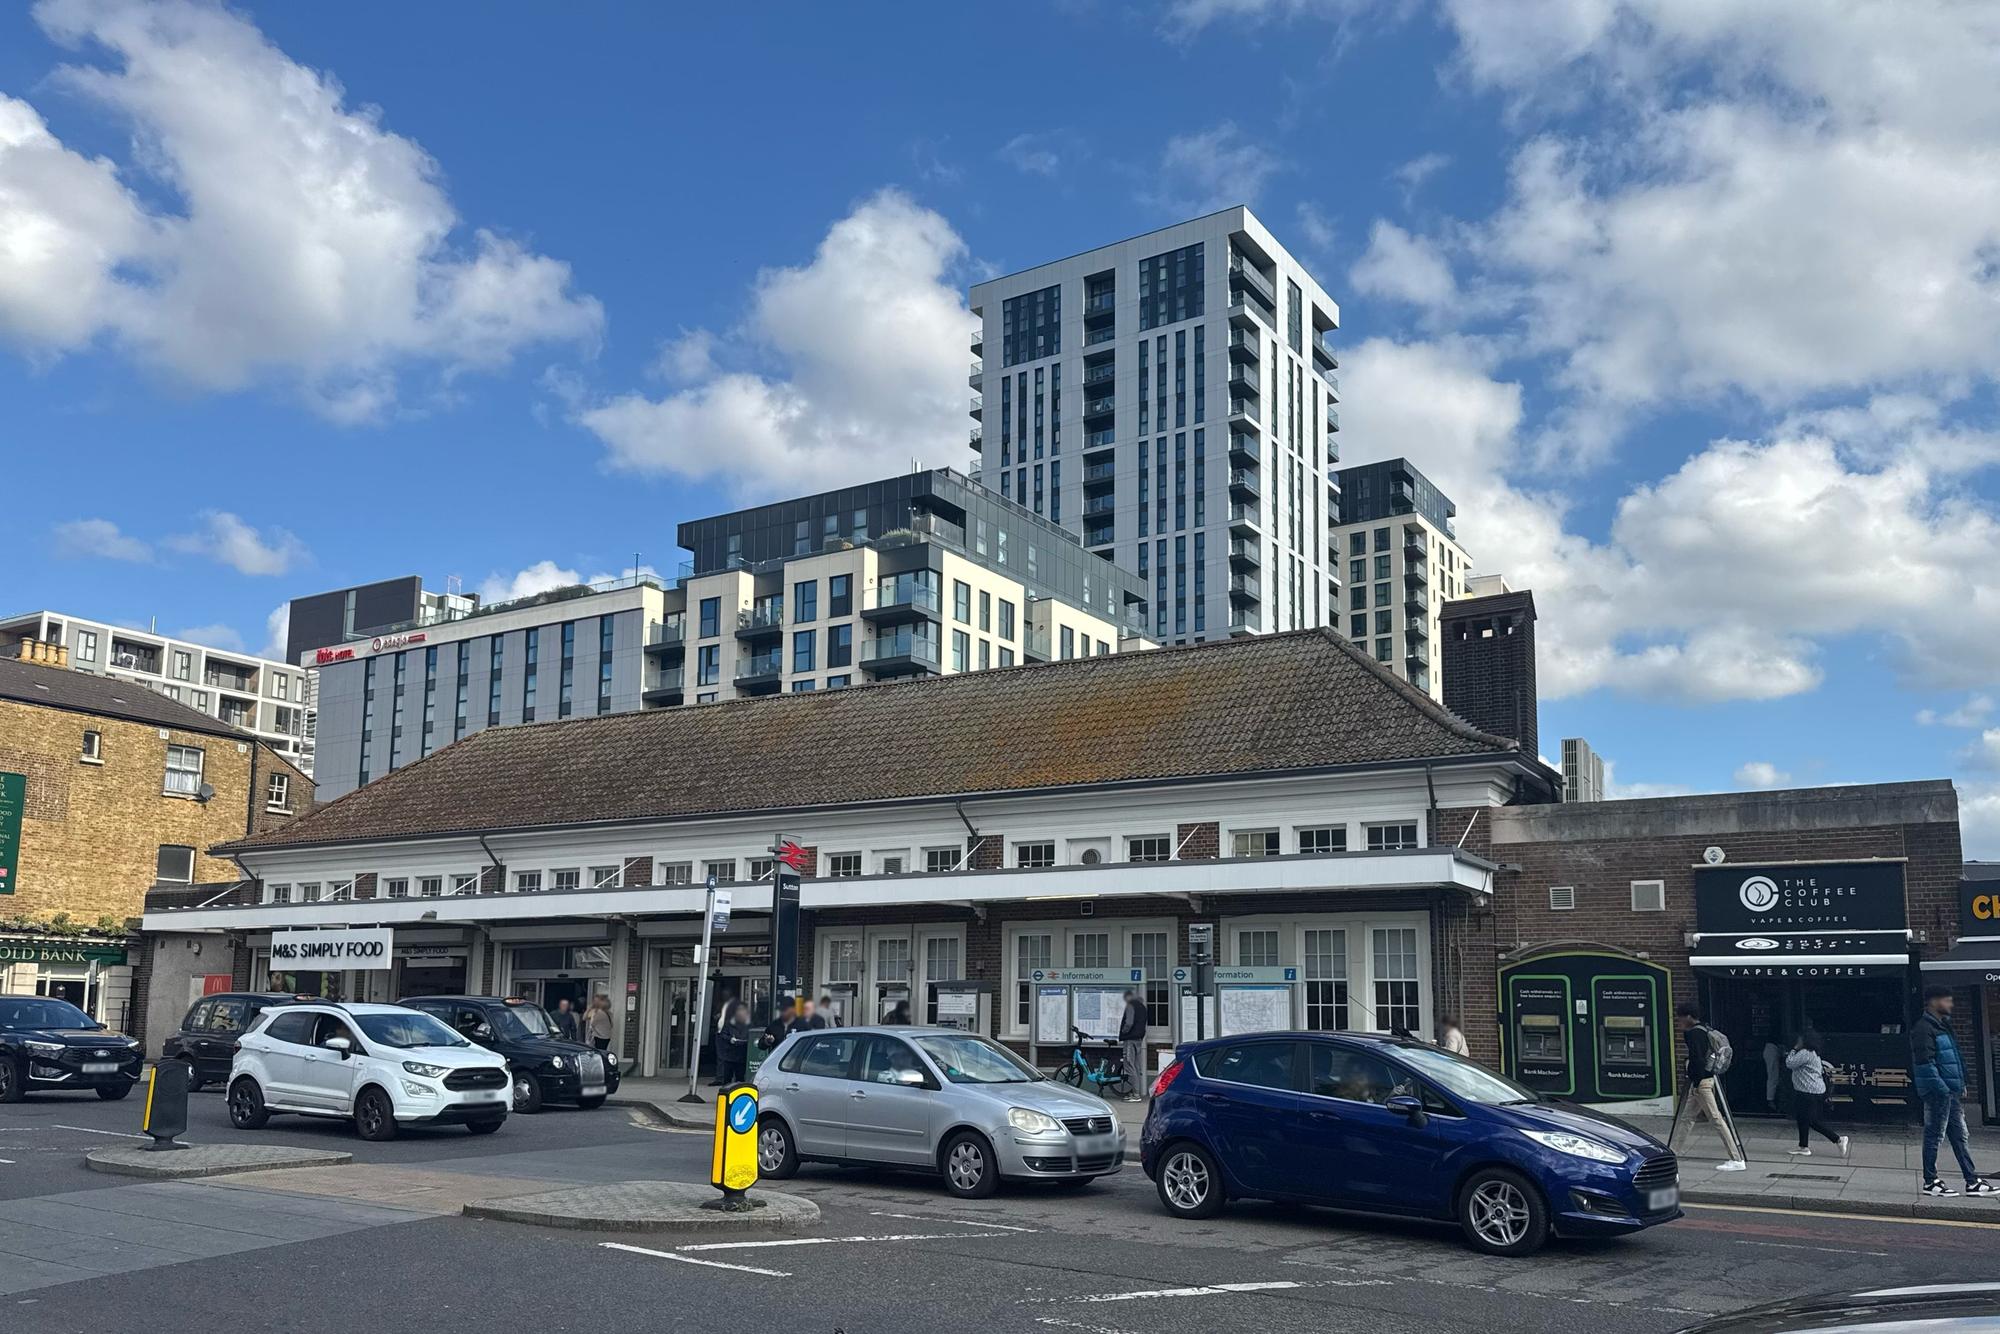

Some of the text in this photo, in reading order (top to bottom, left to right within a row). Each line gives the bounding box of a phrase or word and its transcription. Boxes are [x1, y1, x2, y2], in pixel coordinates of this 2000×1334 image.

[1784, 878, 1816, 887] THE
[1784, 887, 1857, 897] COFFEE
[1784, 898, 1830, 907] CLUB
[0, 946, 87, 961] OLD BANK
[272, 941, 384, 959] M&S SIMPLY FOOD
[1729, 968, 1866, 976] VAPE & COFFEE
[1985, 973, 2000, 982] Op
